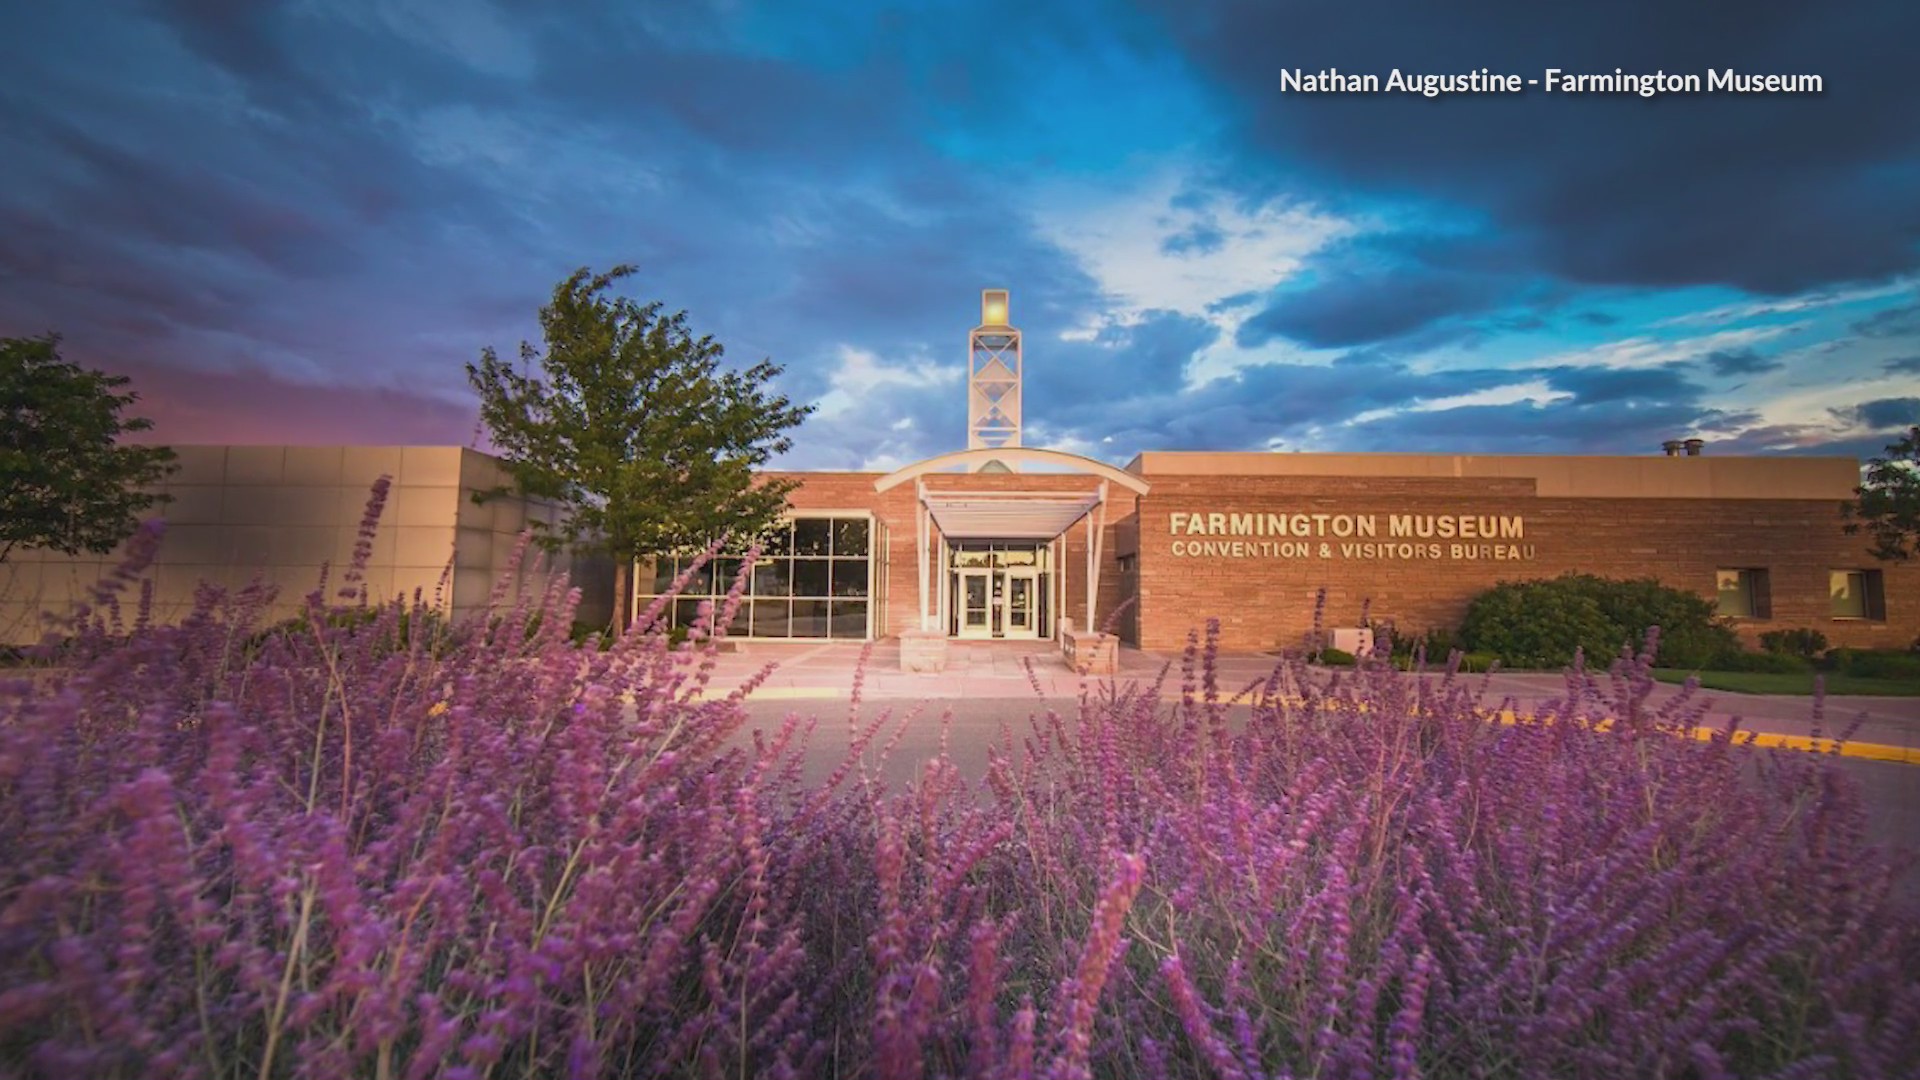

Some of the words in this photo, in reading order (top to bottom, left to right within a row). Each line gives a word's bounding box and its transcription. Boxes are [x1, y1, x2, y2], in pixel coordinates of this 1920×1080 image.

[1170, 512, 1377, 538] FARMINGTON
[1389, 515, 1524, 539] MUSEUM
[1171, 541, 1309, 558] CONVENTION
[1319, 543, 1332, 558] &
[1341, 543, 1442, 559] VISITORS
[1451, 544, 1536, 561] BUREAU
